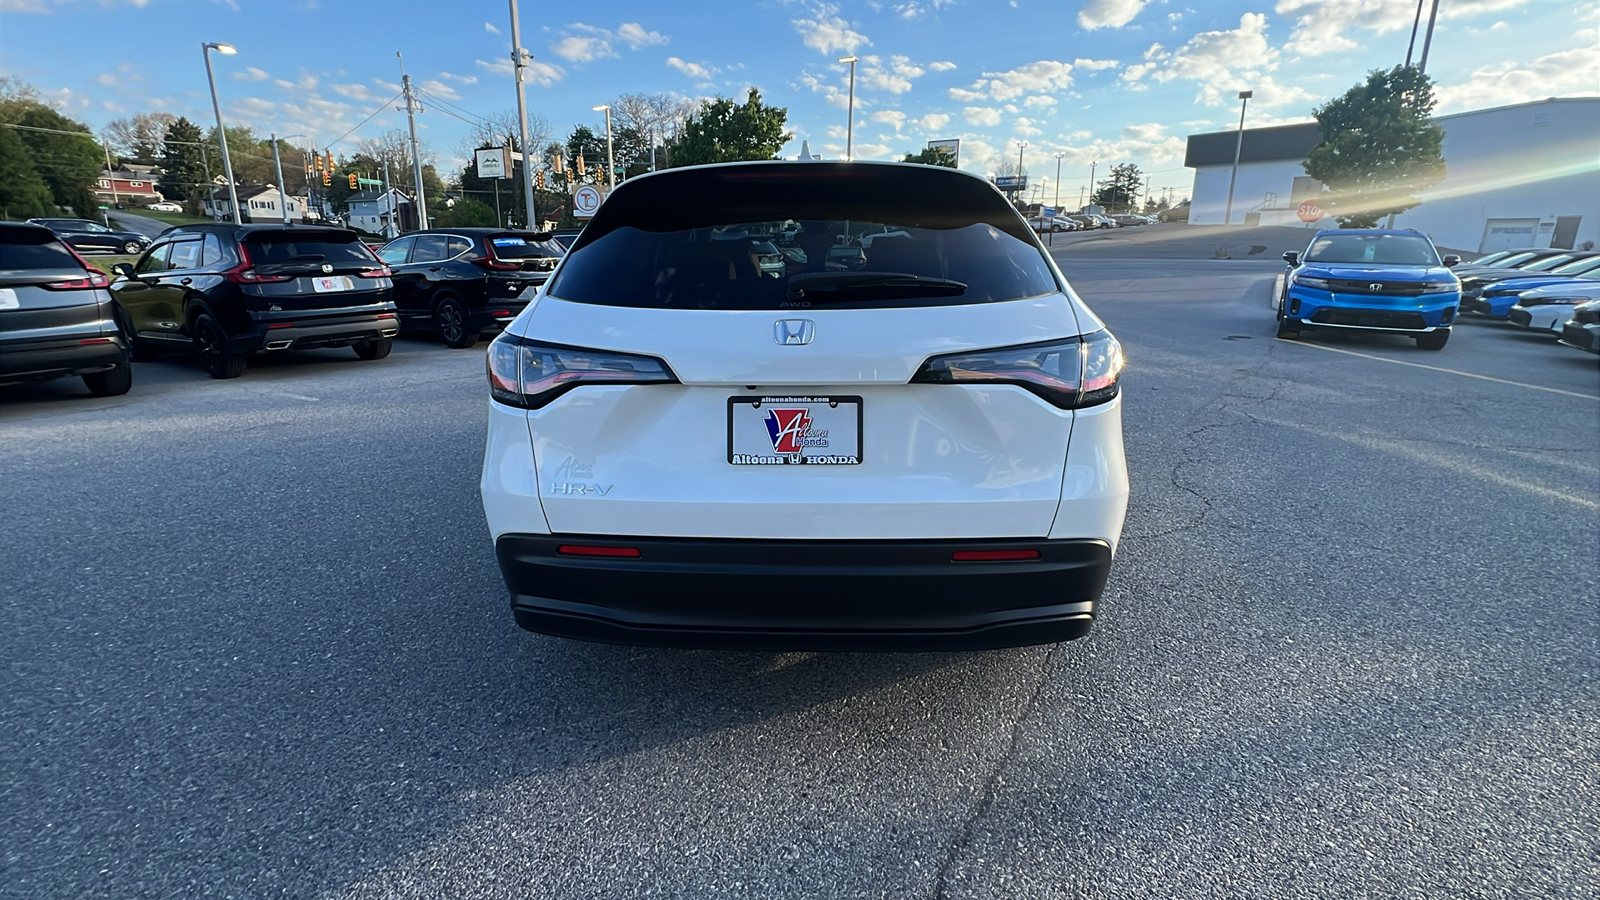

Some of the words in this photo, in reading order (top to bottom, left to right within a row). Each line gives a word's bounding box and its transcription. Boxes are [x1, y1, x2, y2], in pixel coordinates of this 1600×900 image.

[1299, 205, 1324, 216] STOP
[775, 412, 828, 448] Altoona
[796, 437, 828, 447] Honda
[732, 454, 784, 464] Altoona
[806, 455, 859, 465] HONDA
[550, 482, 614, 496] HR-V
